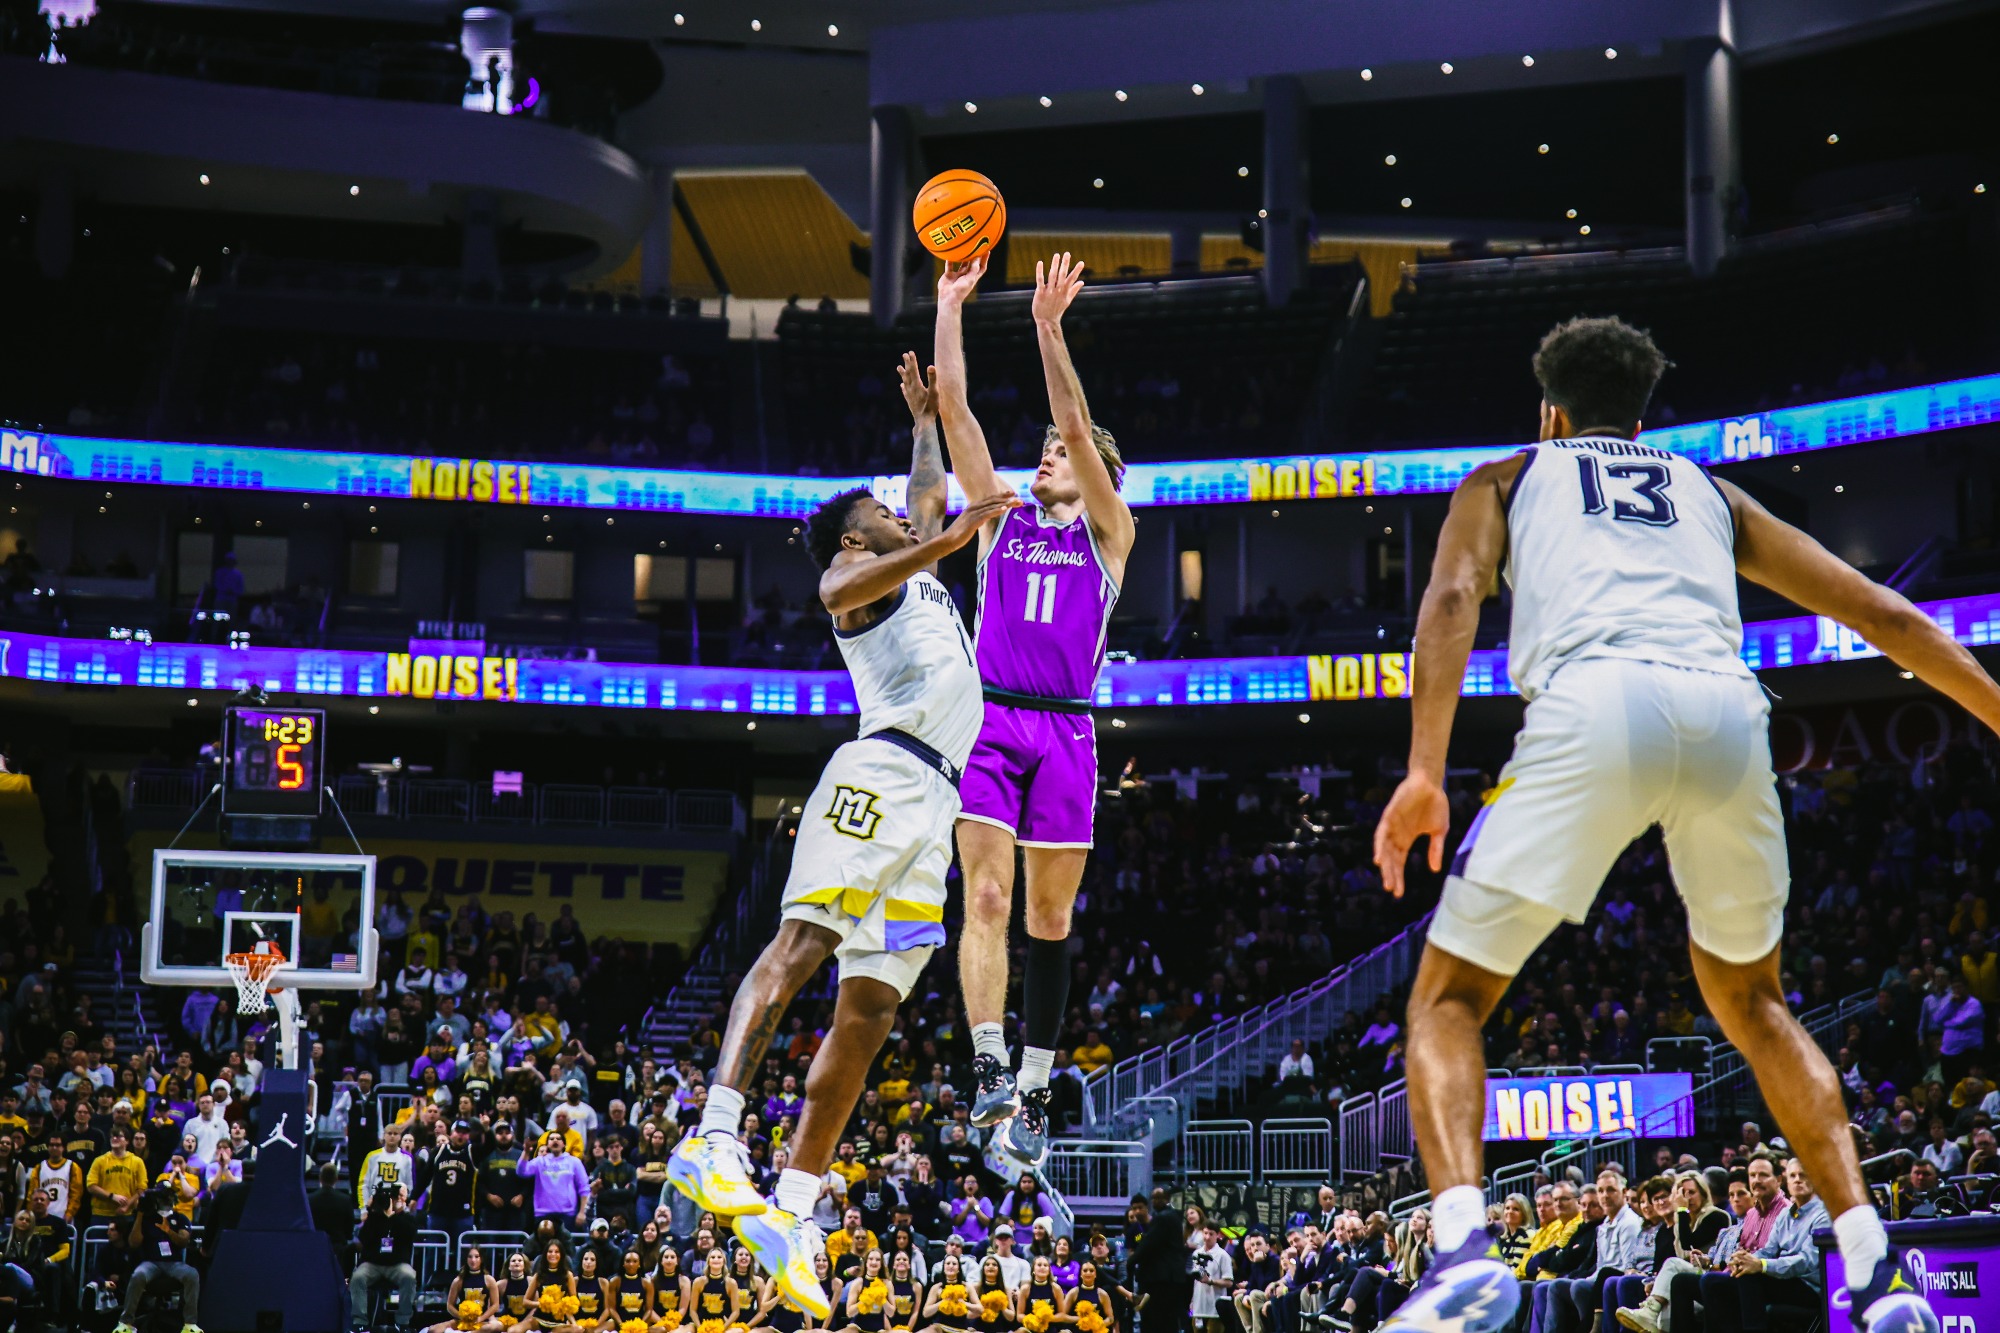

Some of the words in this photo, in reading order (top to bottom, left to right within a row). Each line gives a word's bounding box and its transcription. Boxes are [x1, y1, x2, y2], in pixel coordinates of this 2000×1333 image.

[930, 214, 977, 246] ELITE
[410, 458, 531, 504] NOISE!
[1249, 458, 1375, 502] NOISE!
[1575, 454, 1679, 528] 13
[1025, 541, 1087, 567] Thomas
[1023, 572, 1057, 624] 11
[386, 652, 517, 699] NOISE!
[1307, 652, 1415, 701] NOIS
[264, 716, 312, 744] 1:23
[276, 744, 303, 789] 5
[823, 784, 884, 842] MU
[1495, 1080, 1636, 1141] NOISE!
[378, 1161, 400, 1183] MU
[446, 1169, 457, 1185] 3
[1927, 1271, 1959, 1291] THAT'S
[1959, 1271, 1977, 1290] ALL
